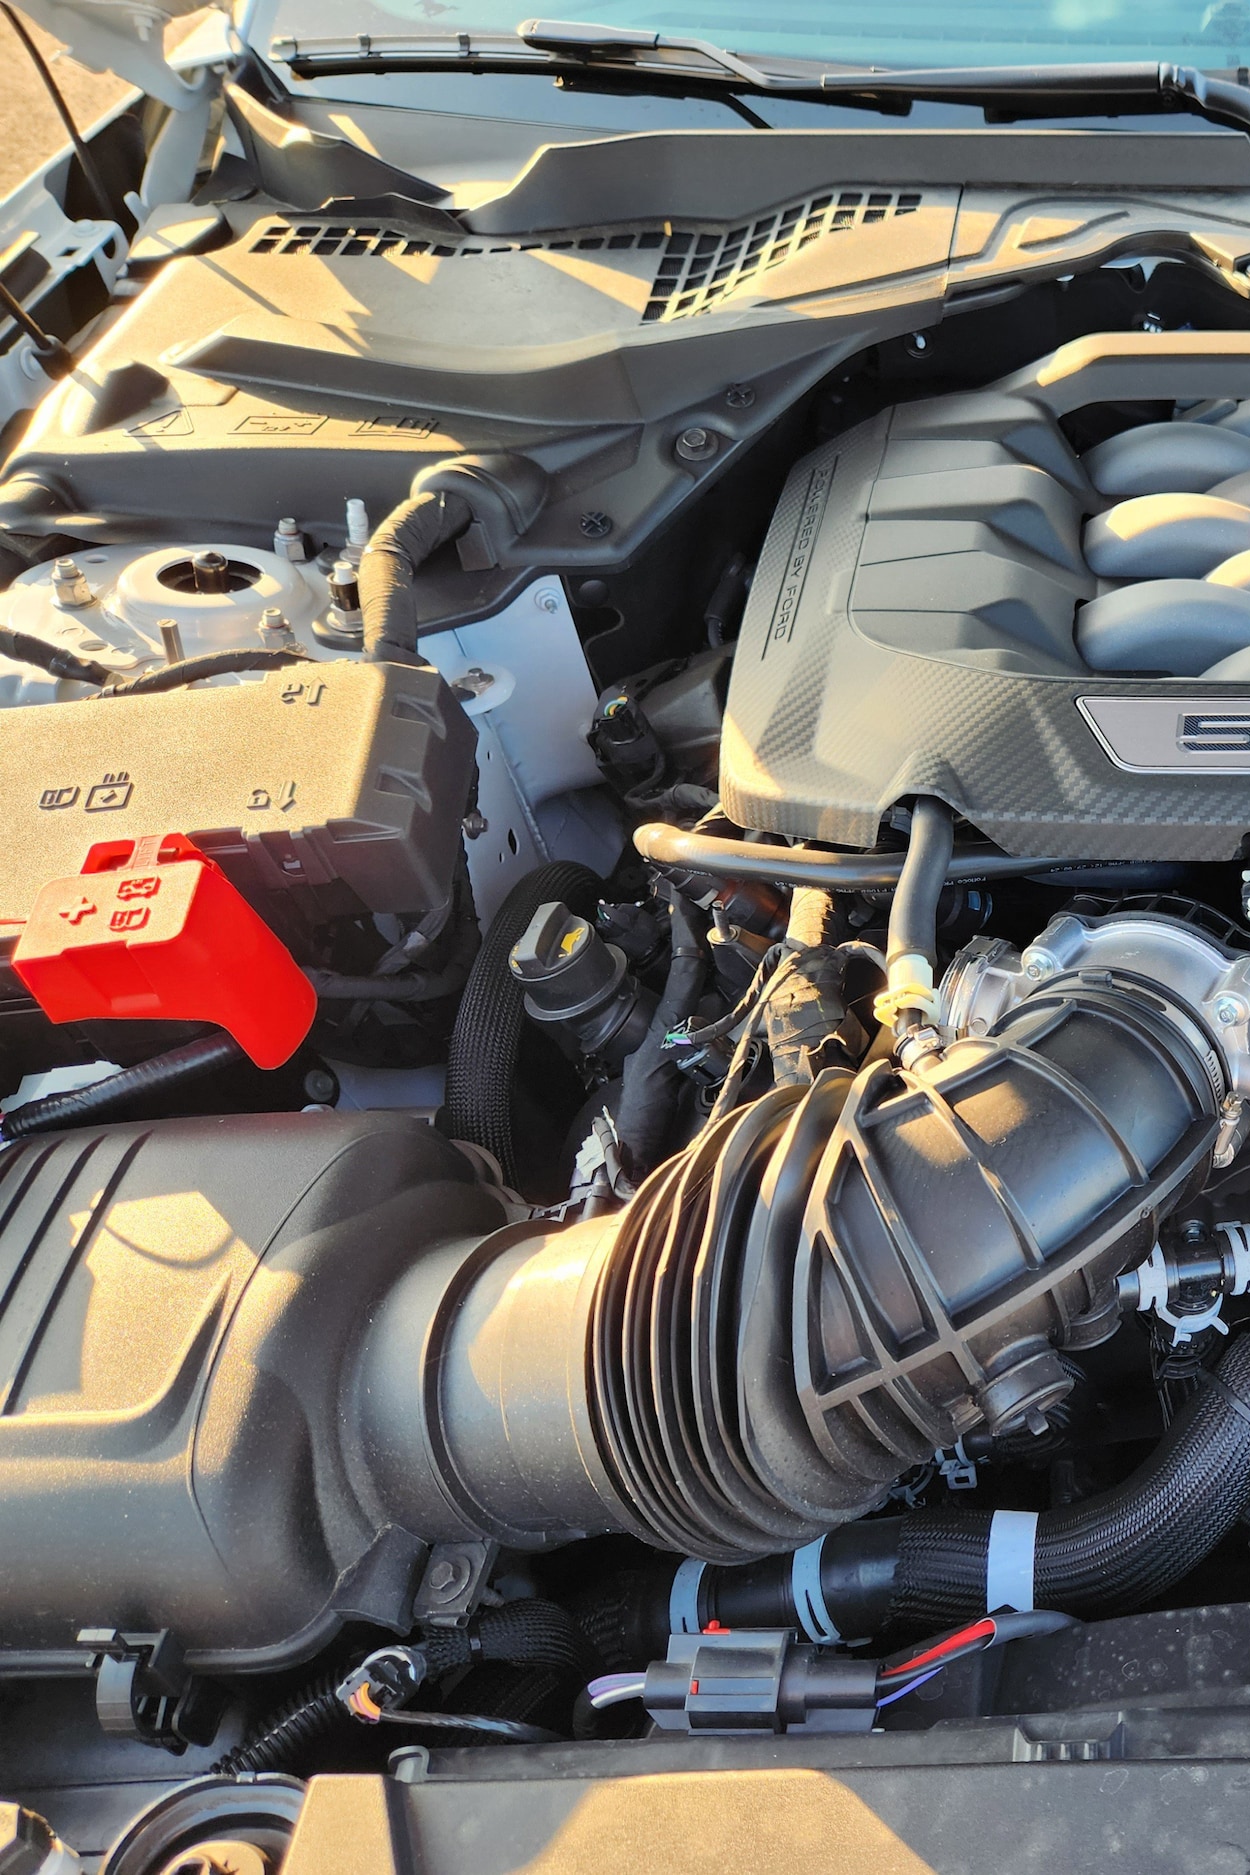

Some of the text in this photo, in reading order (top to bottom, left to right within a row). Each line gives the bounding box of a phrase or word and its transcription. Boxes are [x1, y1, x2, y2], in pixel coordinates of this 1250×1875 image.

[774, 469, 829, 640] POWERED BY FORD
